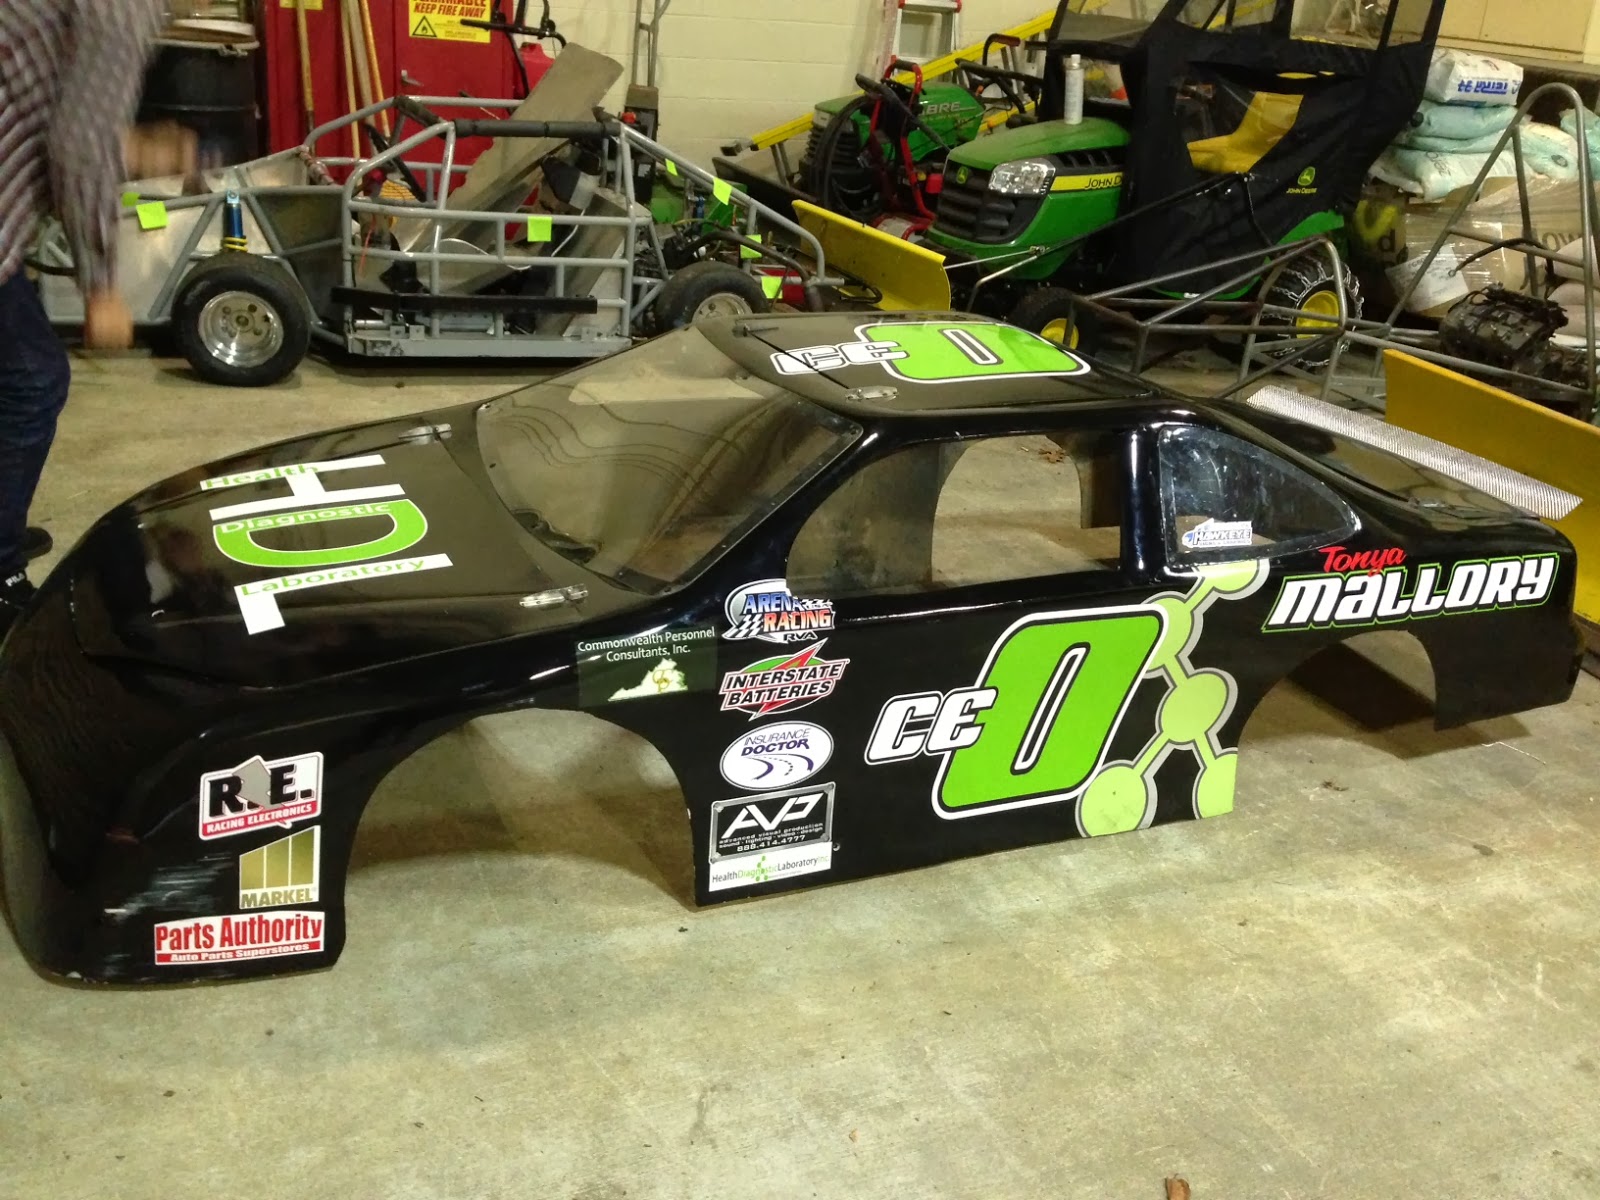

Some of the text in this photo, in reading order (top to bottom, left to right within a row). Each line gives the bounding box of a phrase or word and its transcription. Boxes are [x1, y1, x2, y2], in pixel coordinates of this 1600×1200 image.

[414, 2, 437, 14] KEEP
[437, 4, 459, 16] FIRE
[458, 6, 486, 18] AWAY
[1085, 178, 1113, 189] JOHN
[205, 464, 319, 488] Health
[219, 502, 392, 534] Diagnostic
[1318, 546, 1407, 577] Tonya
[240, 559, 425, 596] Laboratory
[743, 593, 804, 614] ARENA
[763, 609, 832, 632] RACING
[577, 627, 715, 652] Commonwealth Personnel
[783, 631, 817, 641] RVA
[606, 643, 691, 662] Consultants, Inc.
[726, 663, 841, 691] INTERSTATE
[728, 680, 833, 706] BATTERIES
[741, 738, 810, 757] DOCTOR
[743, 728, 812, 746] INSURANCE
[206, 803, 312, 834] RACING ELECTRONICS
[721, 792, 824, 839] AVP
[719, 823, 823, 844] advanced visual production
[240, 887, 313, 908] MARKEL
[155, 914, 322, 951] Parts Authority
[170, 943, 310, 962] Auto Parts Superstores
